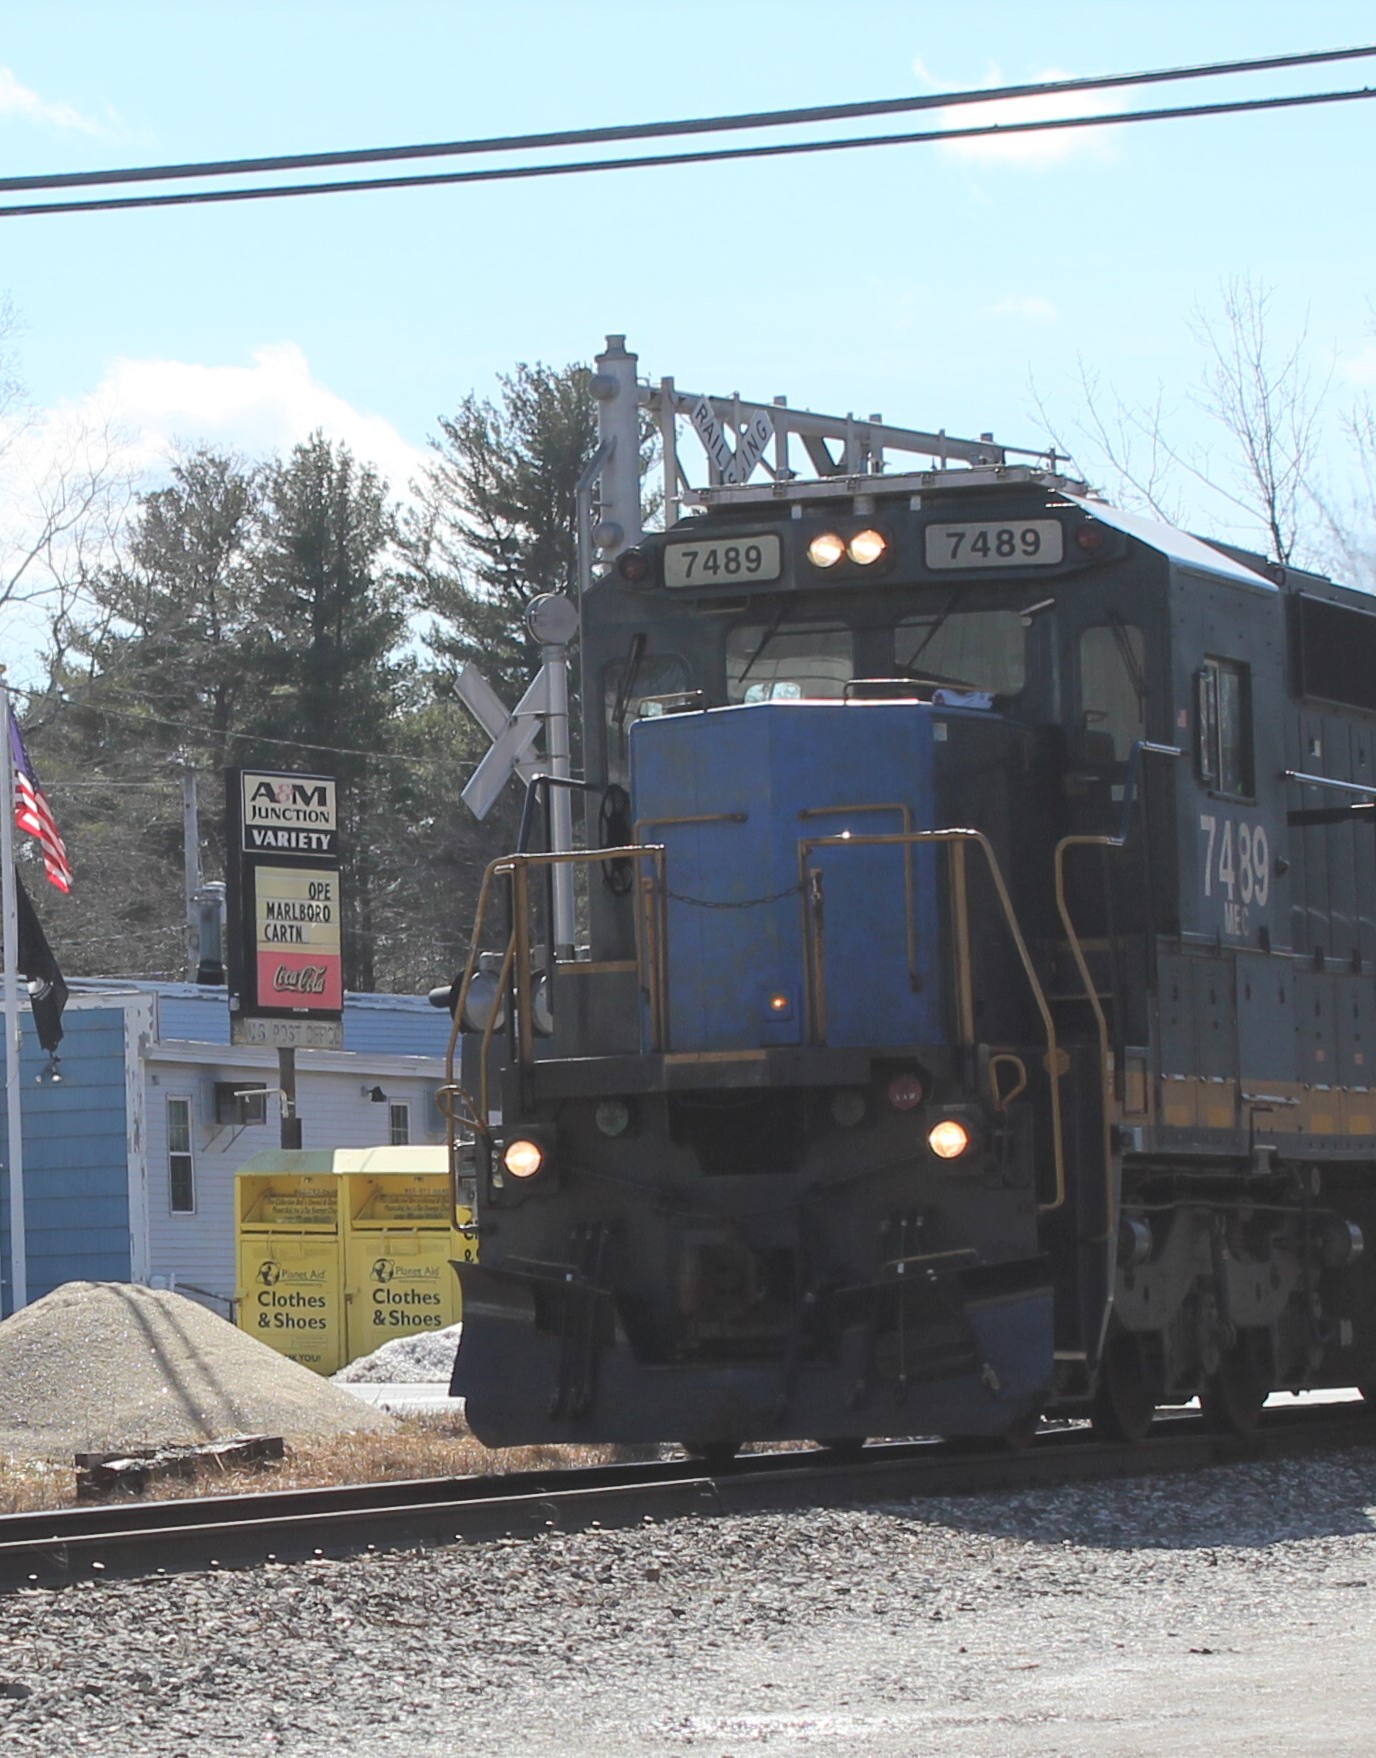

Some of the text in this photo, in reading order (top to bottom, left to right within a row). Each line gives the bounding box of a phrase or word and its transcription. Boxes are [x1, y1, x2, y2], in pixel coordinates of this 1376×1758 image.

[695, 403, 724, 467] RAIL
[945, 527, 1042, 560] 7489
[681, 544, 763, 579] 7489
[250, 781, 328, 808] A&M
[251, 804, 330, 824] JUNCTION
[251, 829, 331, 850] VARIETY
[1199, 813, 1270, 907] 7489
[308, 882, 331, 901] OPE
[266, 901, 331, 923] MARLBORO
[1224, 900, 1250, 937] MEC
[264, 925, 303, 943] CARTN
[273, 1023, 302, 1042] POST
[281, 1268, 325, 1279] Planet Aid
[394, 1265, 440, 1276] Planet Aid
[257, 1290, 326, 1308] Clothes
[372, 1288, 441, 1305] Clothes
[258, 1312, 327, 1330] & Shoes
[373, 1310, 442, 1327] & Shoes
[299, 1353, 321, 1363] YOU!
